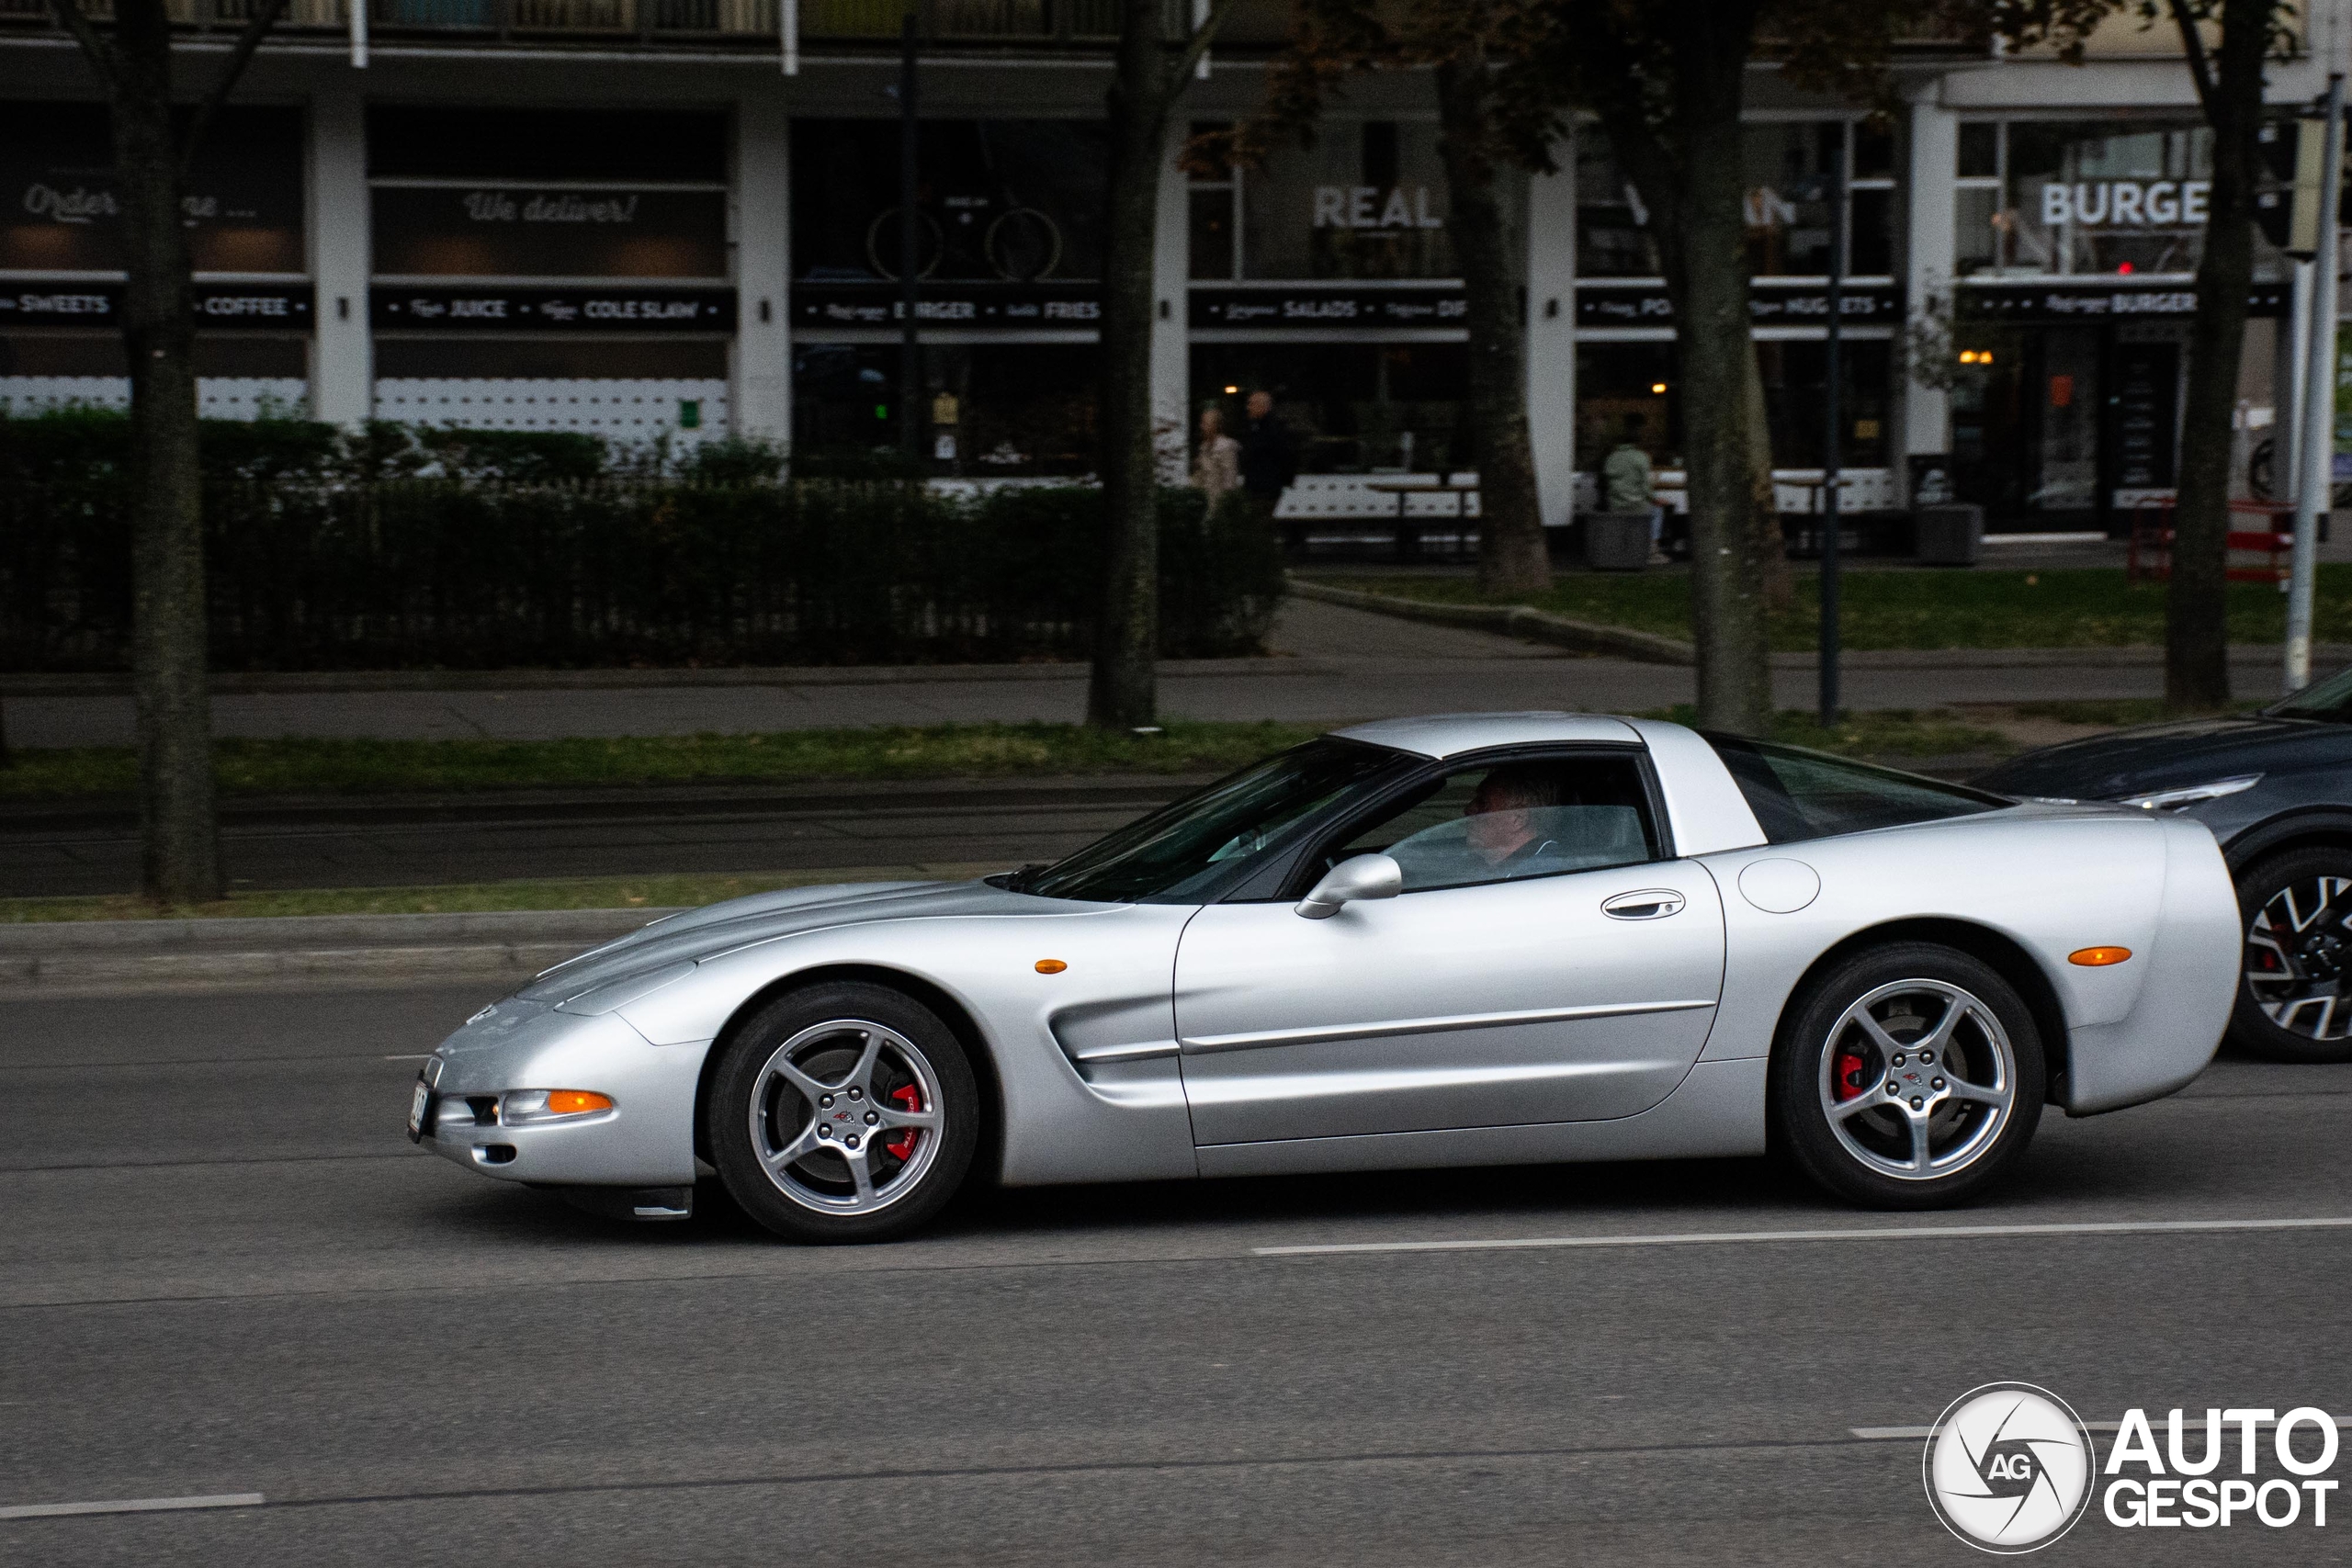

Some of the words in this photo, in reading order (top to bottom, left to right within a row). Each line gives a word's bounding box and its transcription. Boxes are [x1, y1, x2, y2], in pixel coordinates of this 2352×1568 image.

[1313, 186, 1442, 228] REAL
[2042, 182, 2214, 225] BURGE
[18, 294, 111, 313] SWEETS
[204, 297, 289, 316] COFFEE
[449, 299, 508, 318] JUICE
[2112, 292, 2198, 313] BURGER
